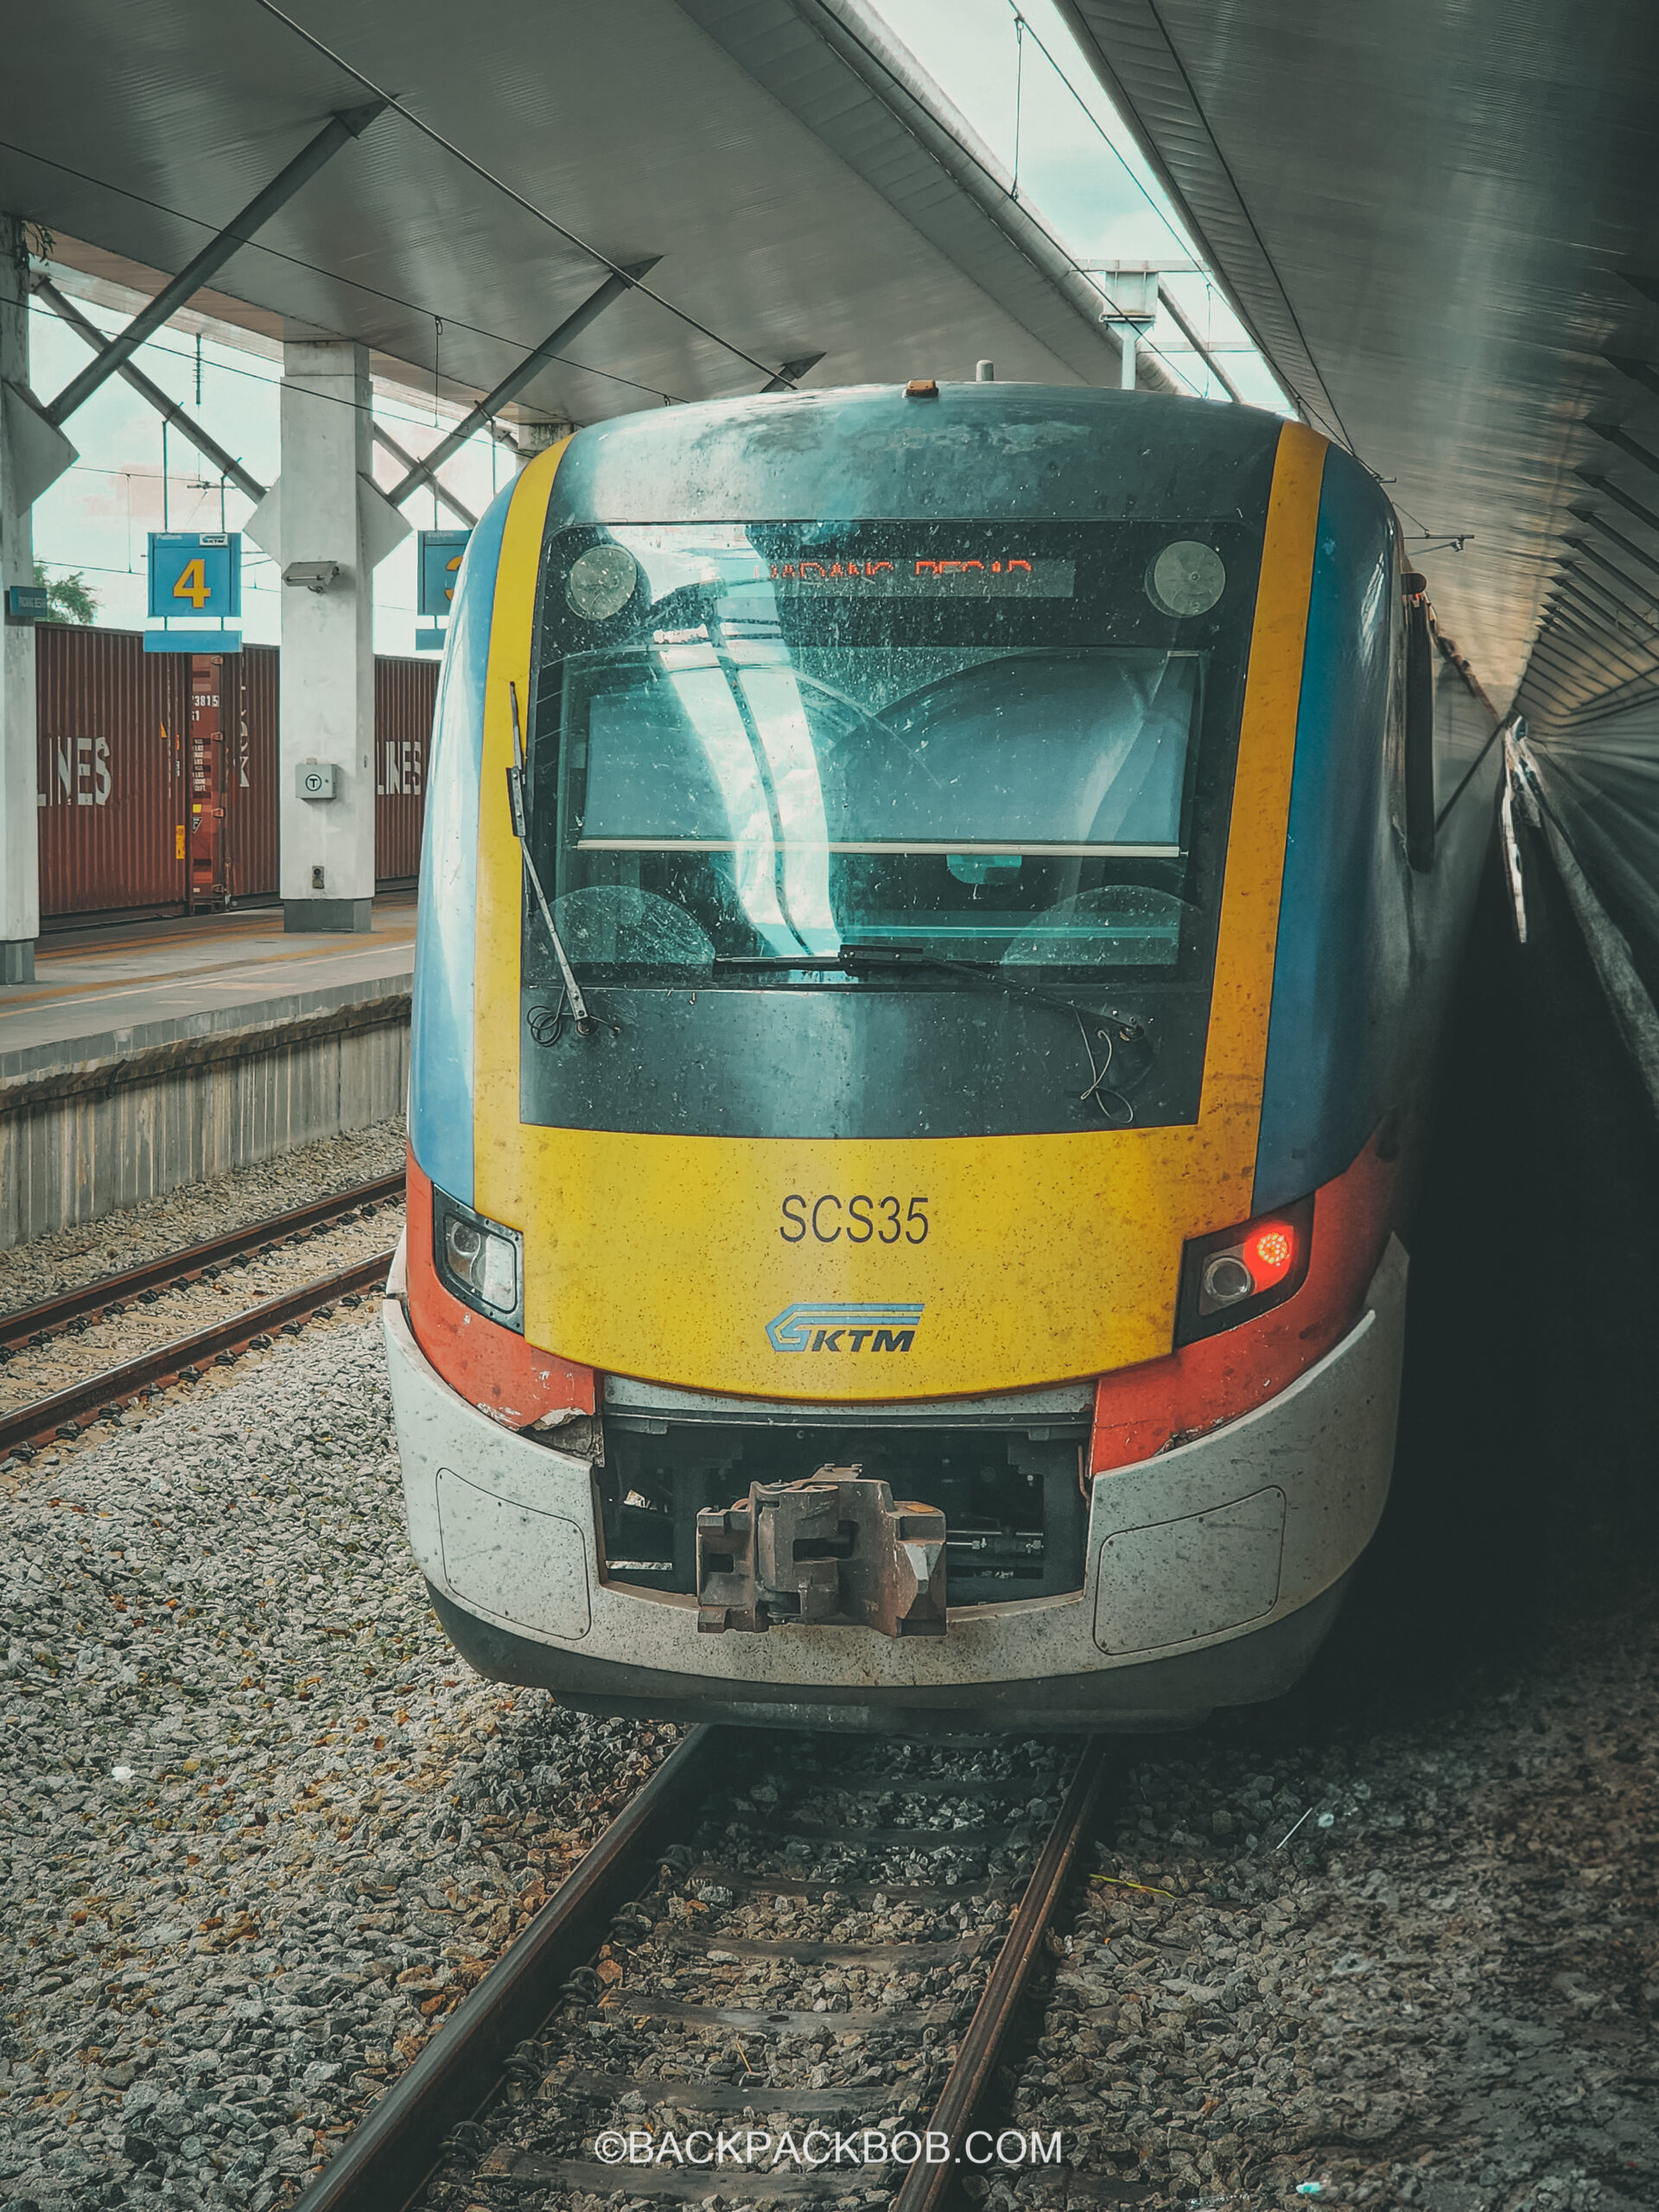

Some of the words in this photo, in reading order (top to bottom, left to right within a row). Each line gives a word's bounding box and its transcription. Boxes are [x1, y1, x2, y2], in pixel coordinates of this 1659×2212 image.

[173, 558, 212, 608] 4
[192, 695, 219, 708] 3815
[36, 736, 111, 806] INES
[779, 1194, 929, 1244] SCS35
[810, 1330, 916, 1352] KTM
